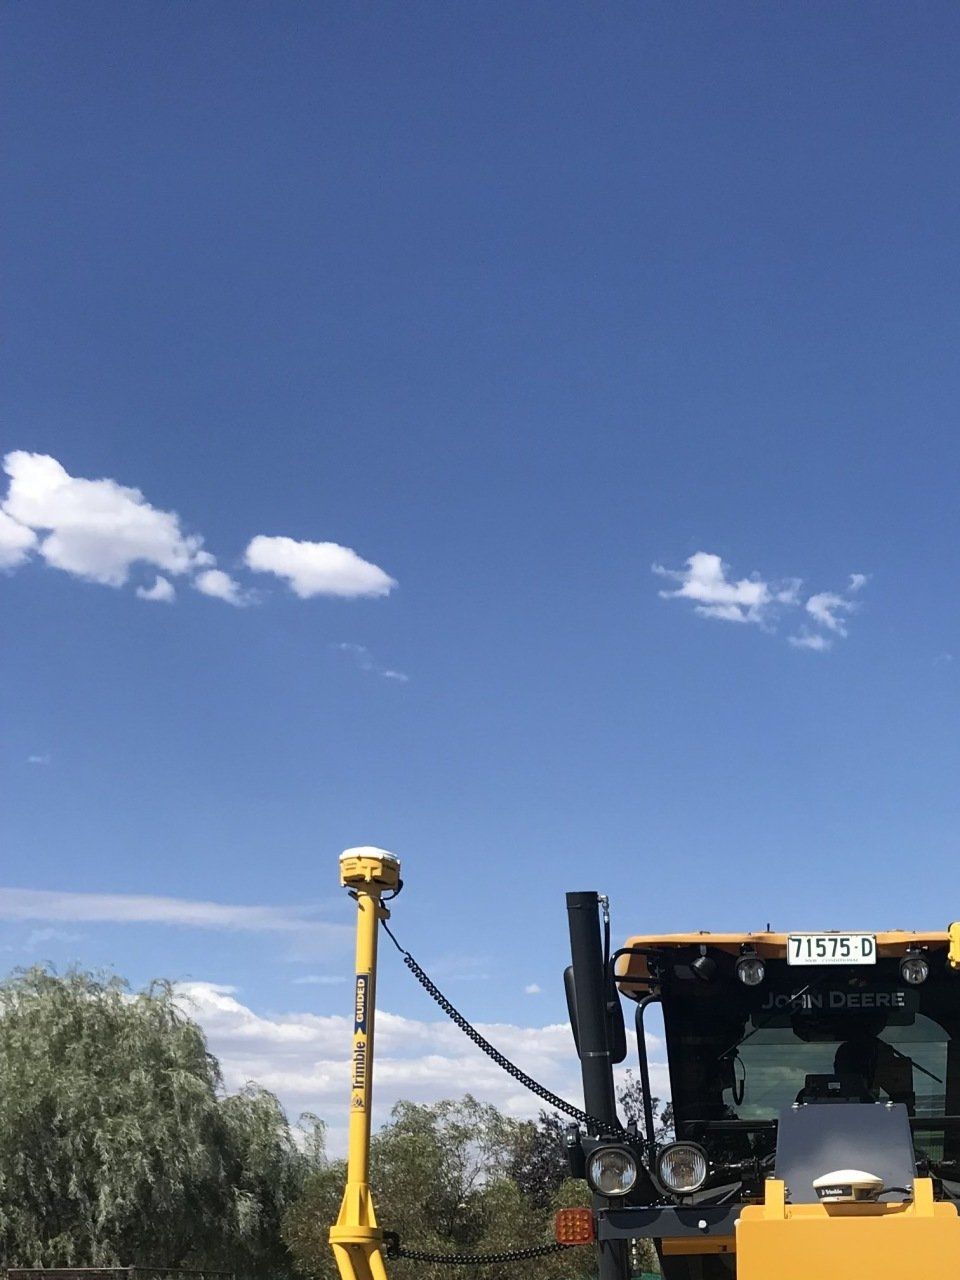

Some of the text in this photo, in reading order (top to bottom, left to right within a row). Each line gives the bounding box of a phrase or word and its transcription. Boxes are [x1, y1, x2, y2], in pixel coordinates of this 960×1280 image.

[829, 991, 905, 1008] DEERE
[353, 977, 366, 1090] Trimble GUIDED
